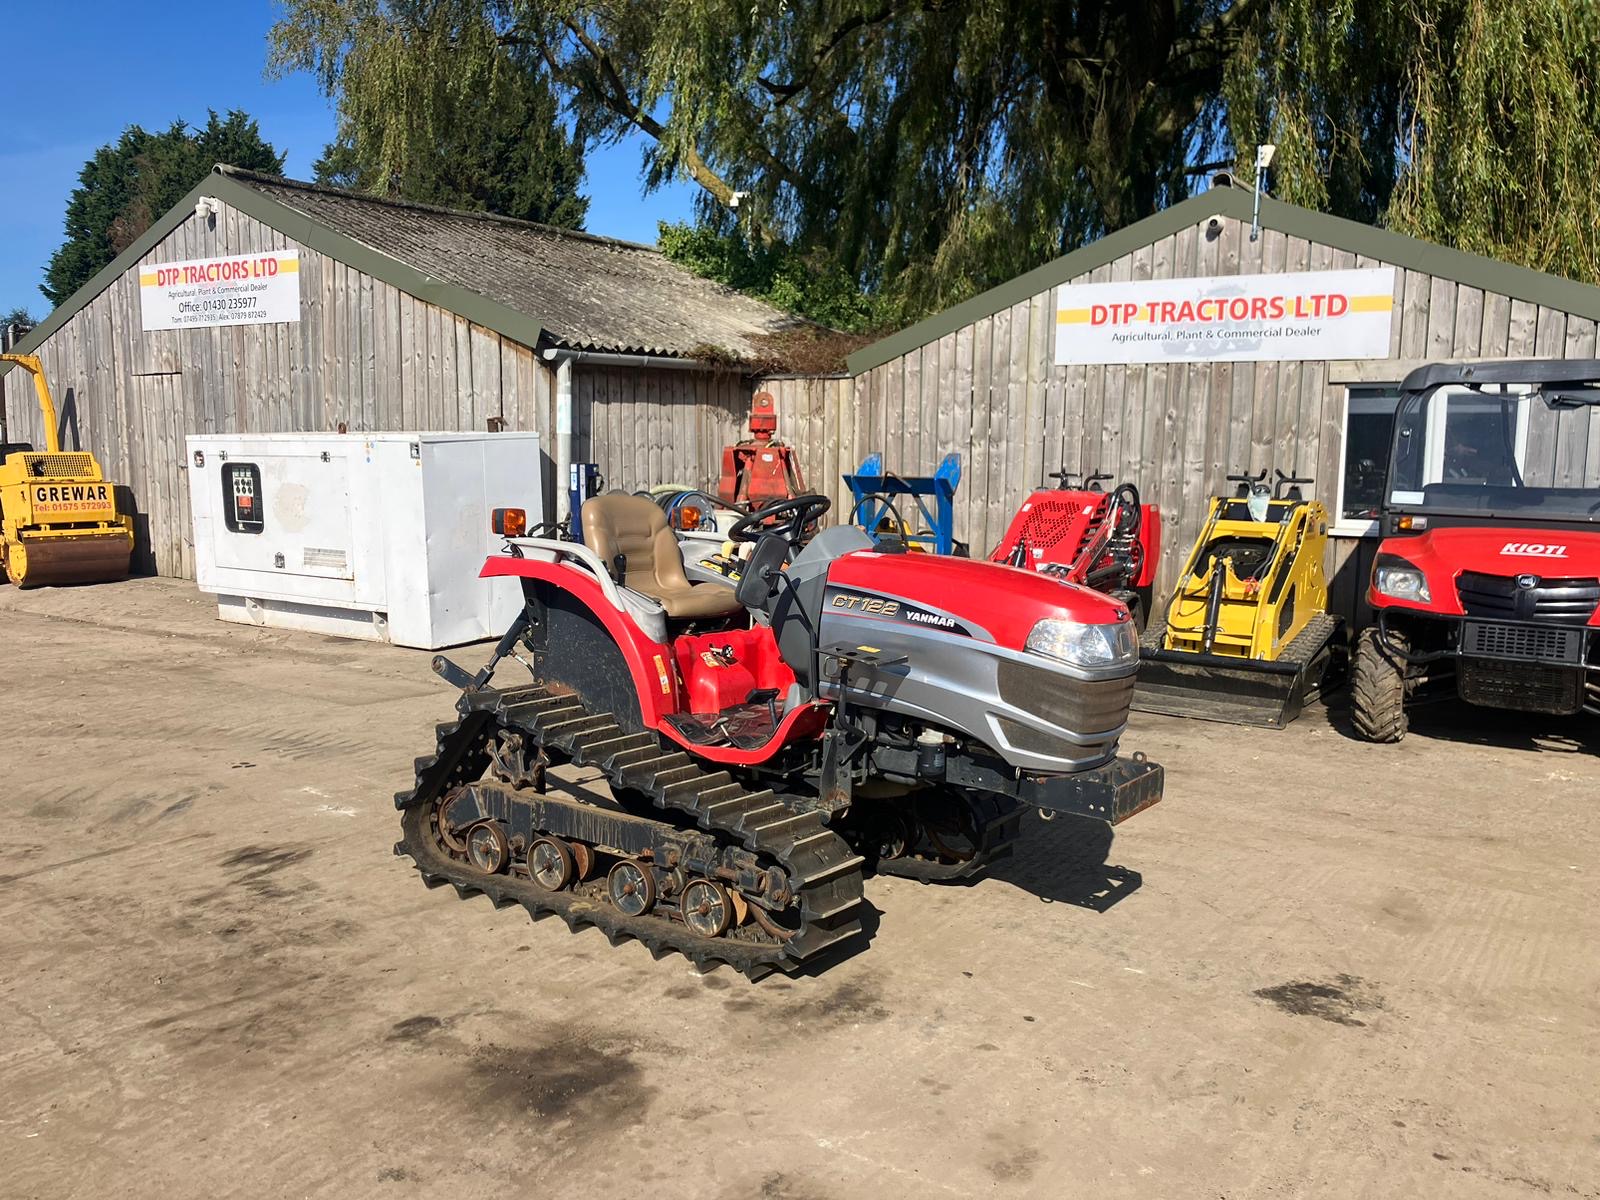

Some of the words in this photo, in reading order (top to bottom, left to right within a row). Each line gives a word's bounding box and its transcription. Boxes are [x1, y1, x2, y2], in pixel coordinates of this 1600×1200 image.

[157, 268, 180, 287] DTP
[183, 260, 249, 284] TRACTORS
[253, 257, 278, 278] LTD
[198, 287, 211, 296] Plant
[212, 287, 216, 295] &
[217, 284, 250, 294] Commercial
[250, 283, 268, 292] Dealer
[178, 301, 202, 313] Office:
[203, 299, 227, 311] 01430
[228, 297, 257, 310] 235977
[1090, 303, 1138, 327] DTP
[1146, 296, 1284, 323] TRACTORS
[1295, 293, 1348, 319] LTD
[248, 310, 267, 319] 872429
[1111, 331, 1173, 344] Agricultural,
[1176, 329, 1203, 341] Plant
[1205, 329, 1214, 339] &
[1217, 327, 1283, 339] Commercial
[1285, 326, 1322, 338] Dealer
[36, 485, 108, 502] GREWAR
[33, 503, 50, 512] Tel:
[52, 502, 79, 511] 01575
[1501, 542, 1567, 556] KIOTI
[832, 594, 901, 617] CT122
[905, 610, 956, 628] YANMAR
